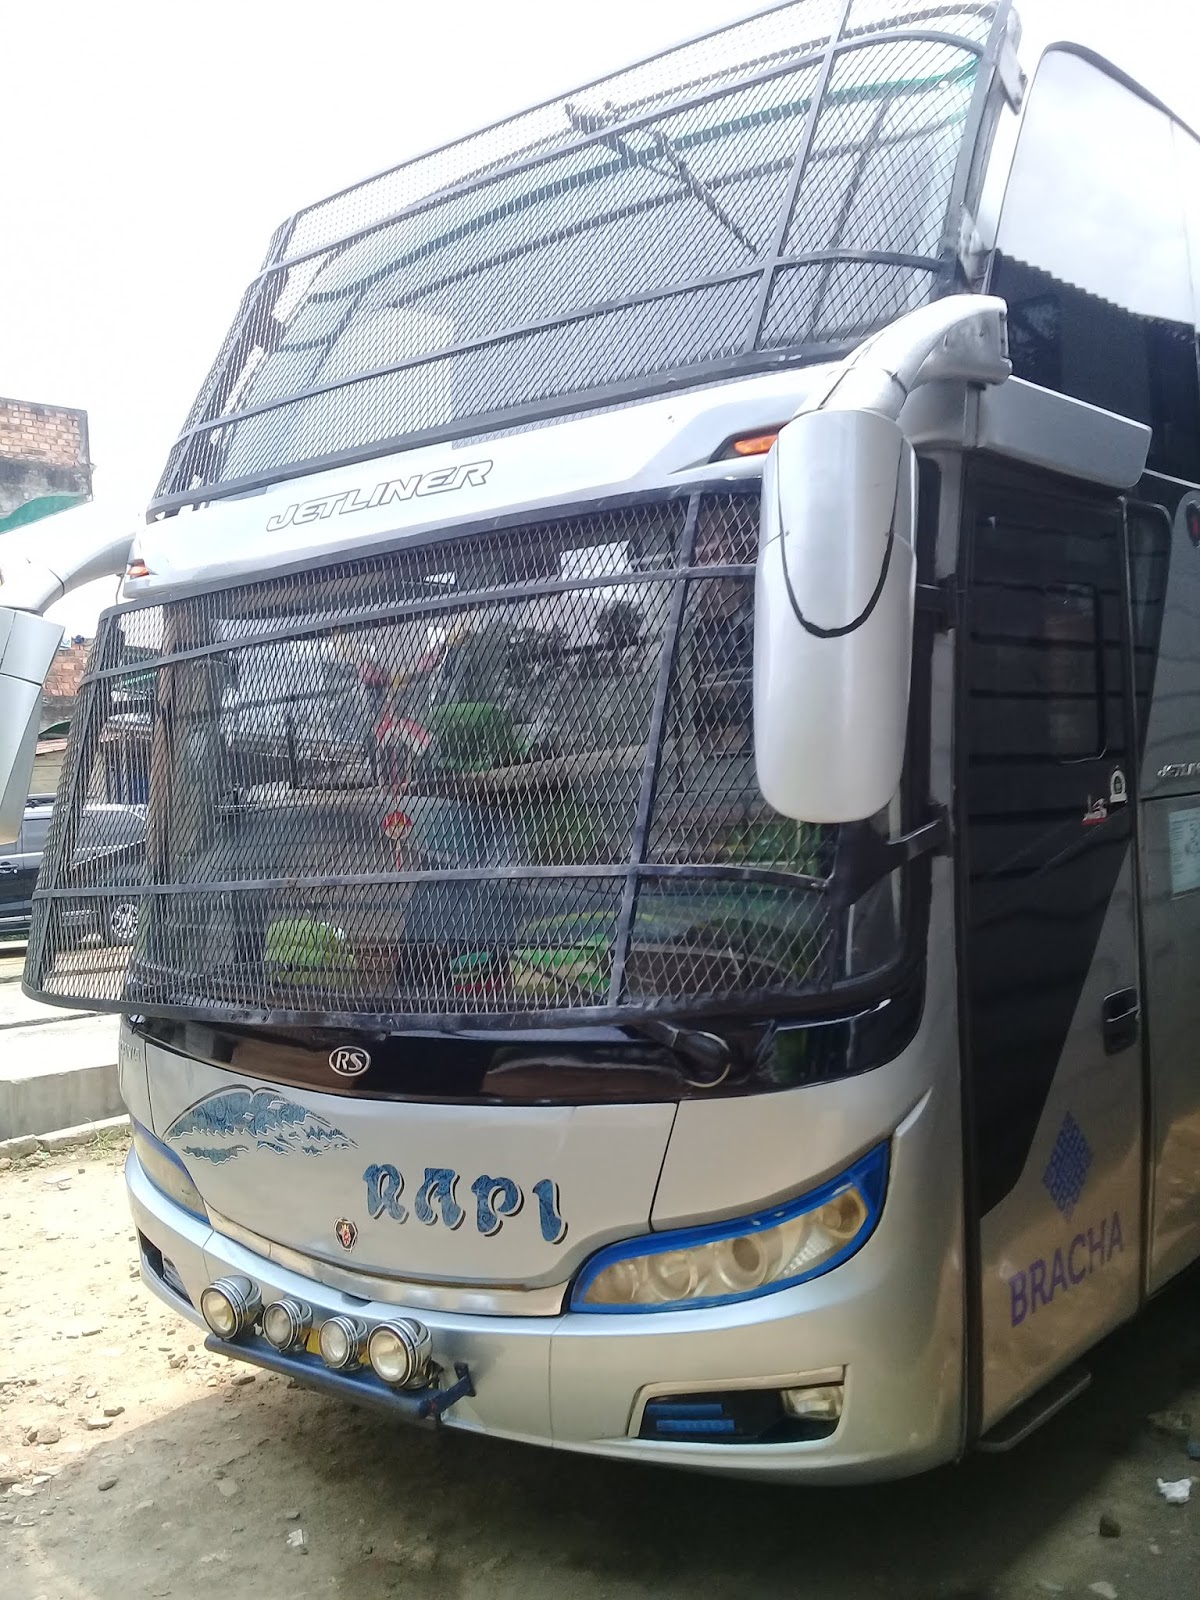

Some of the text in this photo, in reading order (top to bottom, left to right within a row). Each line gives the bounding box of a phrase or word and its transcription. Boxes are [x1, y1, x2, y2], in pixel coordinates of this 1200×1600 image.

[266, 460, 493, 532] JETLINER
[334, 1050, 366, 1072] RS
[363, 1163, 568, 1245] RAPI
[1009, 1210, 1124, 1328] BRACHA
